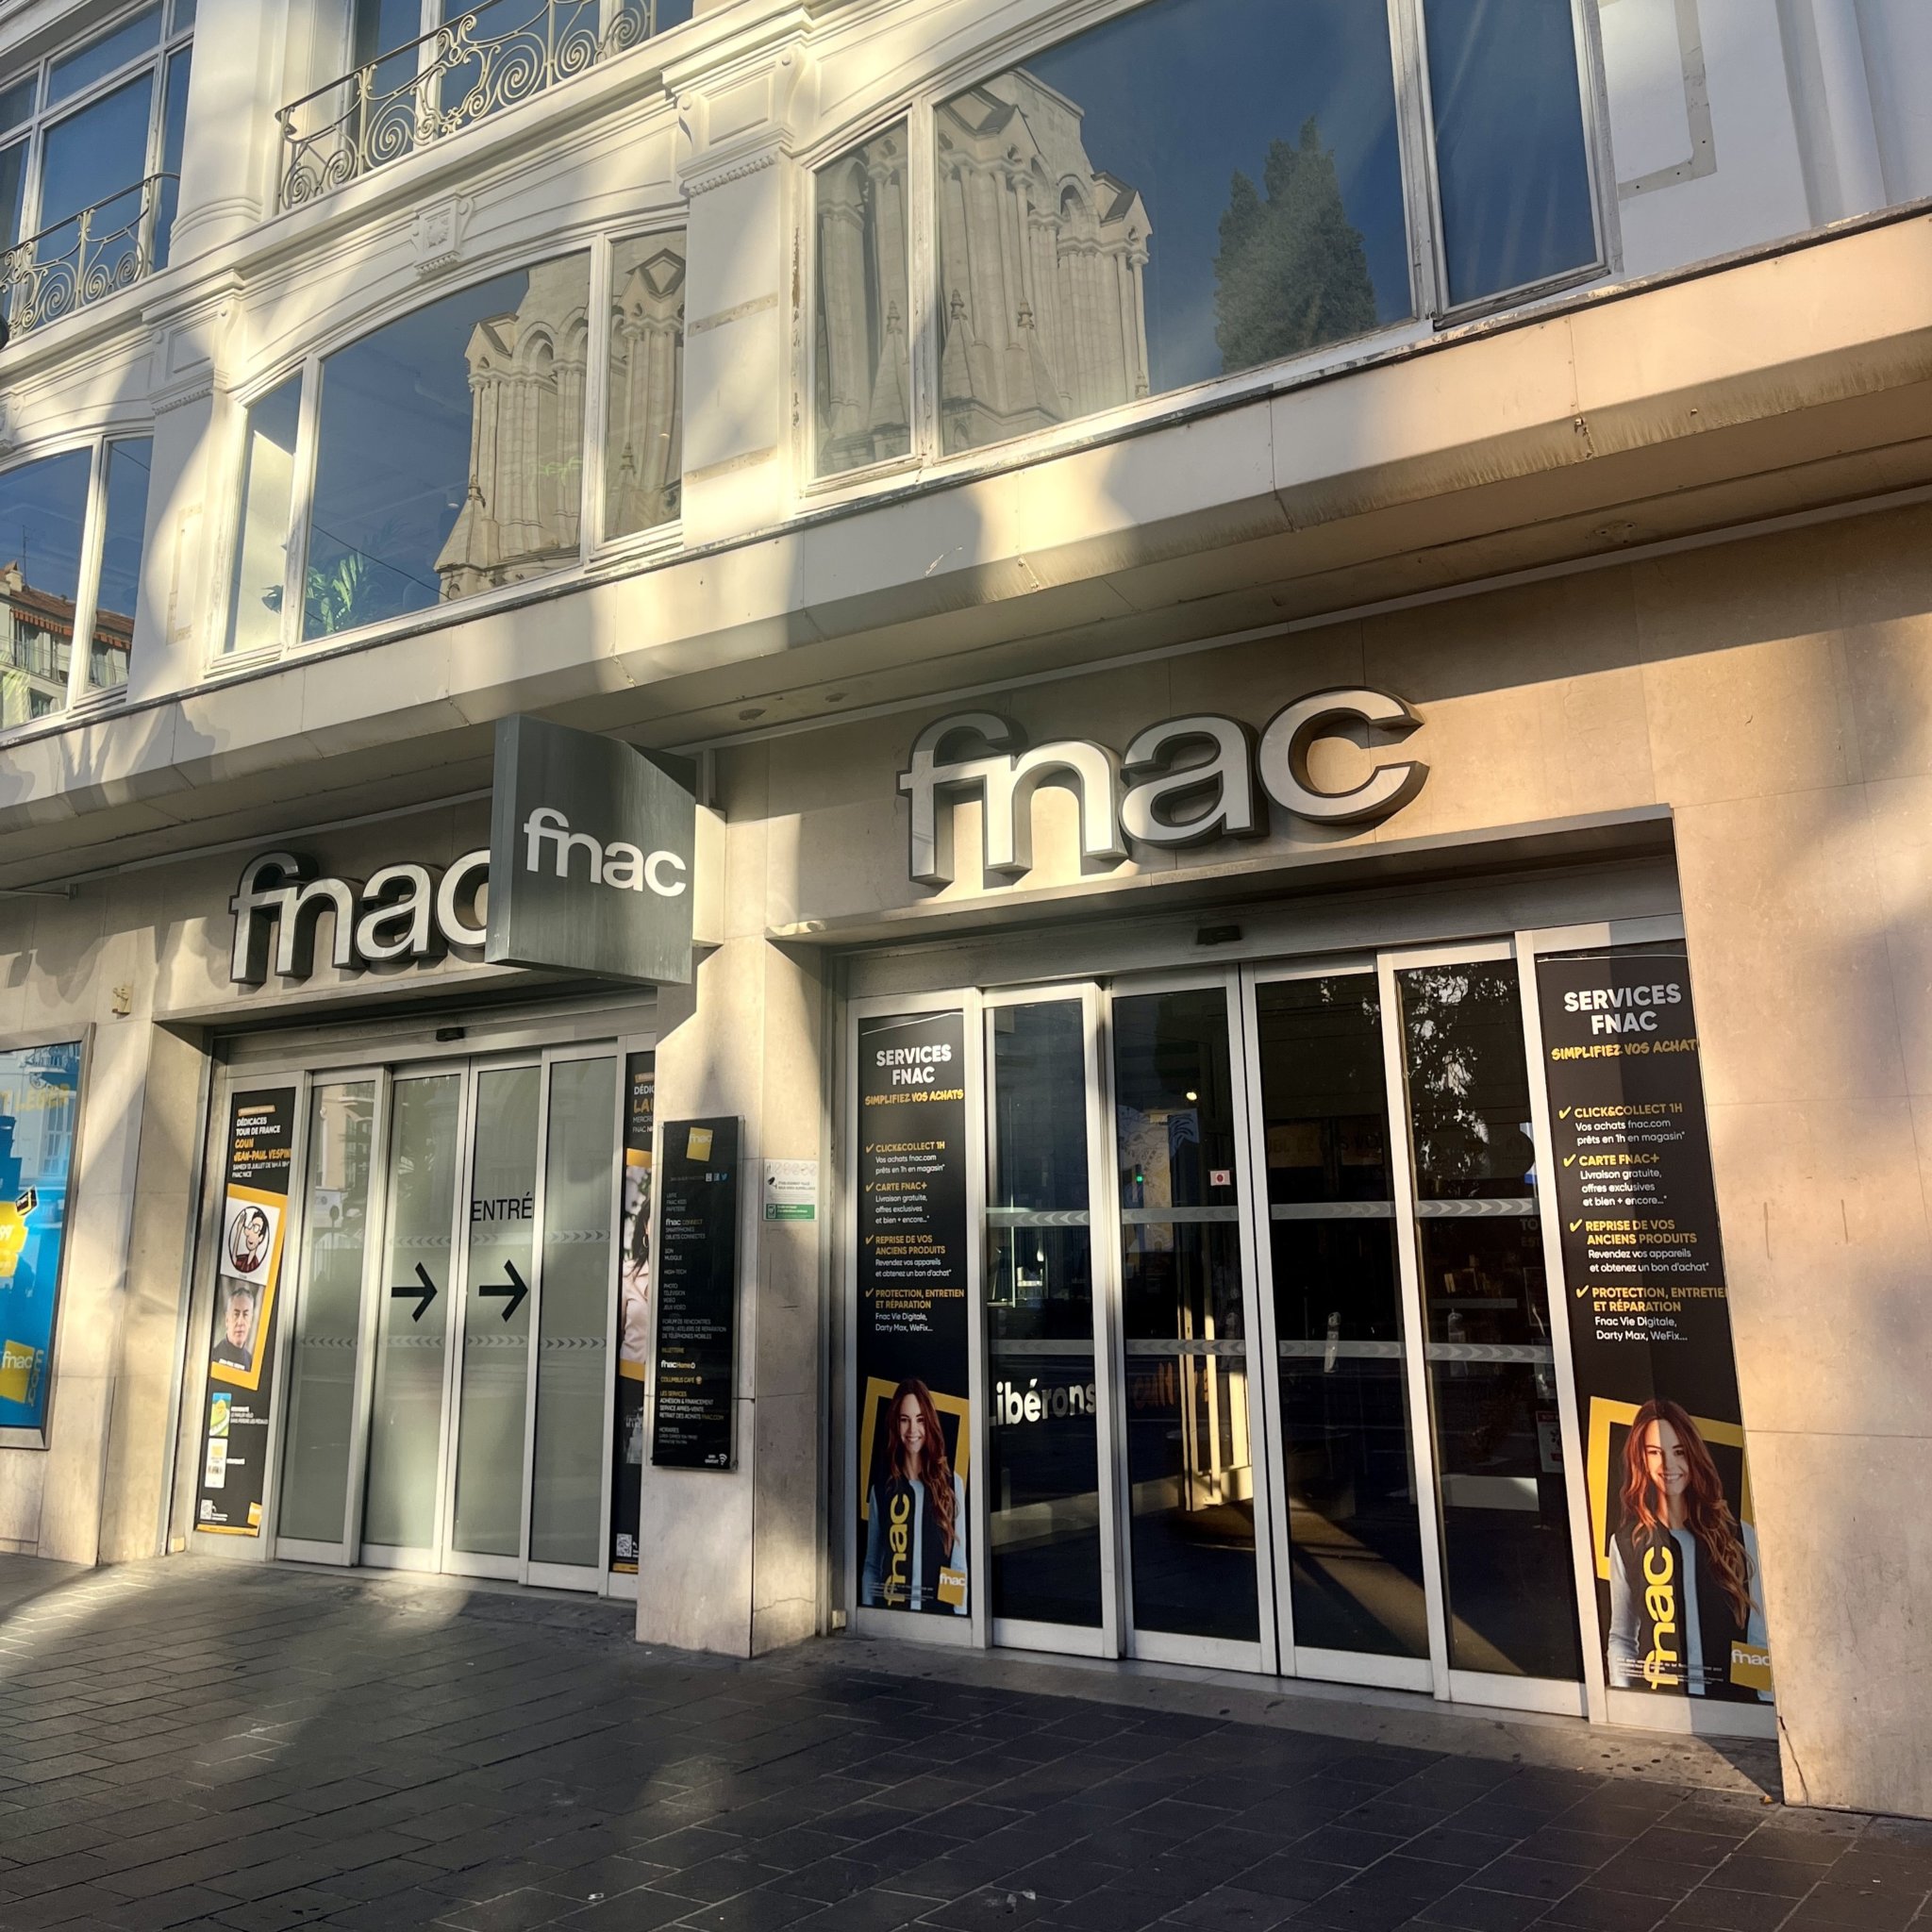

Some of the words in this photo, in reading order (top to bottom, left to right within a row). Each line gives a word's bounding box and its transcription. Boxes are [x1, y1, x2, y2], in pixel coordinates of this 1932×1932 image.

[897, 686, 1428, 885] fnac
[524, 808, 686, 897] fnac
[230, 849, 491, 983] fnac
[1564, 983, 1682, 1013] SERVICES
[1591, 1010, 1658, 1036] FNAC
[876, 1044, 952, 1066] SERVICES
[1551, 1044, 1623, 1061] SIMPLIFIEZ
[1624, 1041, 1651, 1056] VOS
[1652, 1039, 1698, 1054] ACHAT
[892, 1066, 935, 1086] FNAC
[865, 1092, 911, 1106] SIMPLIFIEZ
[911, 1091, 928, 1103] VOS
[929, 1089, 963, 1101] ACHATS
[1574, 1104, 1667, 1119] CLICK&COLLECT
[1669, 1103, 1683, 1113] 1H
[237, 1116, 267, 1126] DÉDICACES
[1574, 1123, 1592, 1132] Vos
[1593, 1121, 1626, 1131] achats
[1627, 1119, 1671, 1130] fnac.com
[236, 1127, 250, 1137] TOUR
[251, 1126, 258, 1136] DE
[258, 1124, 281, 1135] FRANCE
[690, 1133, 712, 1143] fnac
[1577, 1134, 1601, 1147] prêts
[1602, 1135, 1614, 1144] en
[1616, 1134, 1626, 1143] 1h
[1627, 1134, 1641, 1142] en
[875, 1142, 935, 1154] CLICK&COLLECT
[936, 1141, 945, 1151] 1H
[233, 1149, 268, 1162] JEAN-PAUL
[887, 1155, 908, 1163] achats
[908, 1154, 937, 1162] fnac.com
[1579, 1155, 1616, 1167] CARTE
[1619, 1153, 1660, 1165] FNAC+
[875, 1166, 891, 1174] prêts
[1580, 1170, 1621, 1180] Livraison
[1622, 1168, 1662, 1181] gratuite,
[875, 1183, 900, 1191] CARTE
[901, 1181, 927, 1191] FNAC+
[1581, 1183, 1607, 1193] offres
[1608, 1182, 1656, 1192] exclusives
[875, 1194, 901, 1203] Livraison
[902, 1193, 927, 1204] gratuite,
[1583, 1197, 1593, 1207] et
[1594, 1196, 1615, 1207] bien
[892, 1205, 923, 1213] exclusives
[665, 1218, 681, 1226] fnac
[1586, 1221, 1631, 1232] REPRISE
[1633, 1220, 1649, 1230] DE
[1650, 1219, 1675, 1230] VOS
[875, 1236, 905, 1244] REPRISE
[906, 1235, 916, 1243] DE
[917, 1234, 932, 1242] VOS
[1587, 1234, 1637, 1245] ANCIENS
[1639, 1232, 1697, 1244] PRODUITS
[875, 1246, 907, 1256] ANCIENS
[908, 1245, 946, 1255] PRODUITS
[1588, 1249, 1631, 1259] Revendez
[1632, 1250, 1648, 1259] vos
[1649, 1248, 1691, 1260] appareils
[875, 1258, 903, 1267] Revendez
[914, 1257, 941, 1267] appareils
[1590, 1264, 1600, 1273] et
[1600, 1263, 1638, 1274] obtenez
[1638, 1264, 1650, 1273] un
[1651, 1262, 1670, 1272] bon
[875, 1290, 924, 1299] PROTECTION,
[925, 1289, 964, 1297] ENTRETIEN
[1592, 1287, 1669, 1300] PROTECTION,
[886, 1298, 931, 1308] RÉPARATION
[1593, 1301, 1606, 1312] ET
[1608, 1298, 1682, 1312] RÉPARATION
[875, 1312, 891, 1321] Fnac
[891, 1312, 901, 1321] Vie
[902, 1312, 927, 1322] Digitale,
[1595, 1316, 1619, 1326] Fnac
[1620, 1316, 1636, 1326] Vie
[1637, 1315, 1677, 1328] Digitale,
[875, 1324, 892, 1332] Darty
[893, 1324, 908, 1332] Max,
[1596, 1331, 1624, 1342] Darty
[1624, 1331, 1649, 1341] Max,
[2, 1351, 33, 1370] fnac
[991, 1378, 1095, 1426] ibérons
[884, 1493, 910, 1607] fnac
[940, 1573, 967, 1586] fnac
[1642, 1546, 1679, 1690] fnac
